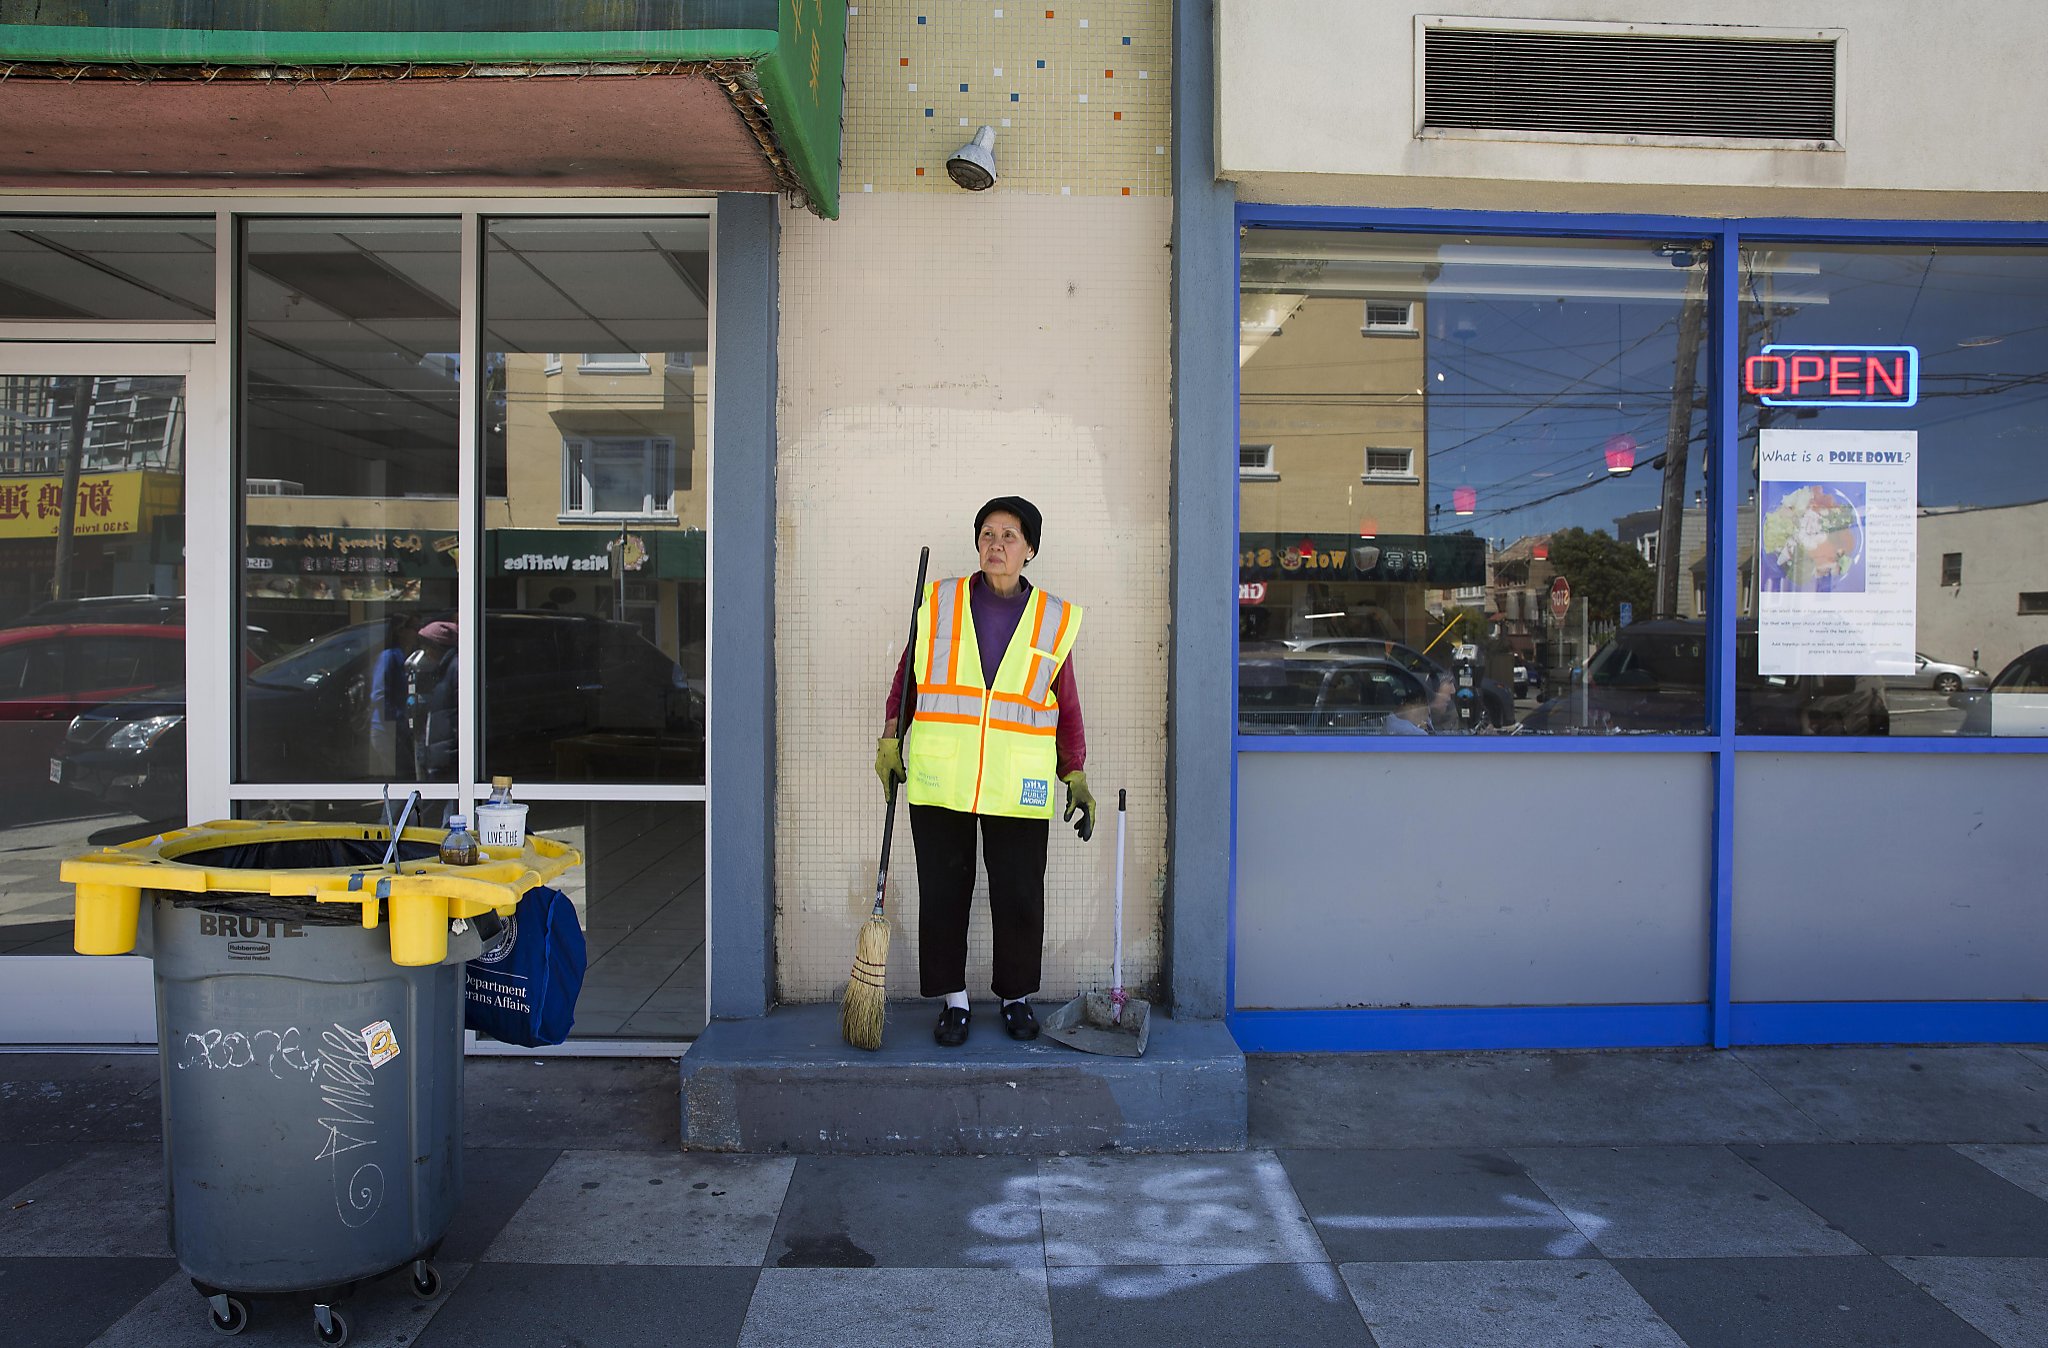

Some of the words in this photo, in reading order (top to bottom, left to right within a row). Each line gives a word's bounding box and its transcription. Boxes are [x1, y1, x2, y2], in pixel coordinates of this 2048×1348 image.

[1745, 355, 1904, 397] OPEN
[1762, 449, 1797, 462] What
[1802, 450, 1812, 462] is
[1816, 452, 1824, 462] a
[1829, 451, 1863, 462] POKE
[1865, 451, 1911, 464] BOWL?
[1022, 797, 1046, 805] WORKS
[1023, 791, 1047, 799] PUBLIC
[487, 831, 503, 844] LIVE
[505, 830, 518, 843] THE
[200, 914, 304, 938] BRUTE
[229, 944, 269, 952] Rubbermaid
[464, 990, 492, 1004] erans
[493, 995, 531, 1014] Affairs
